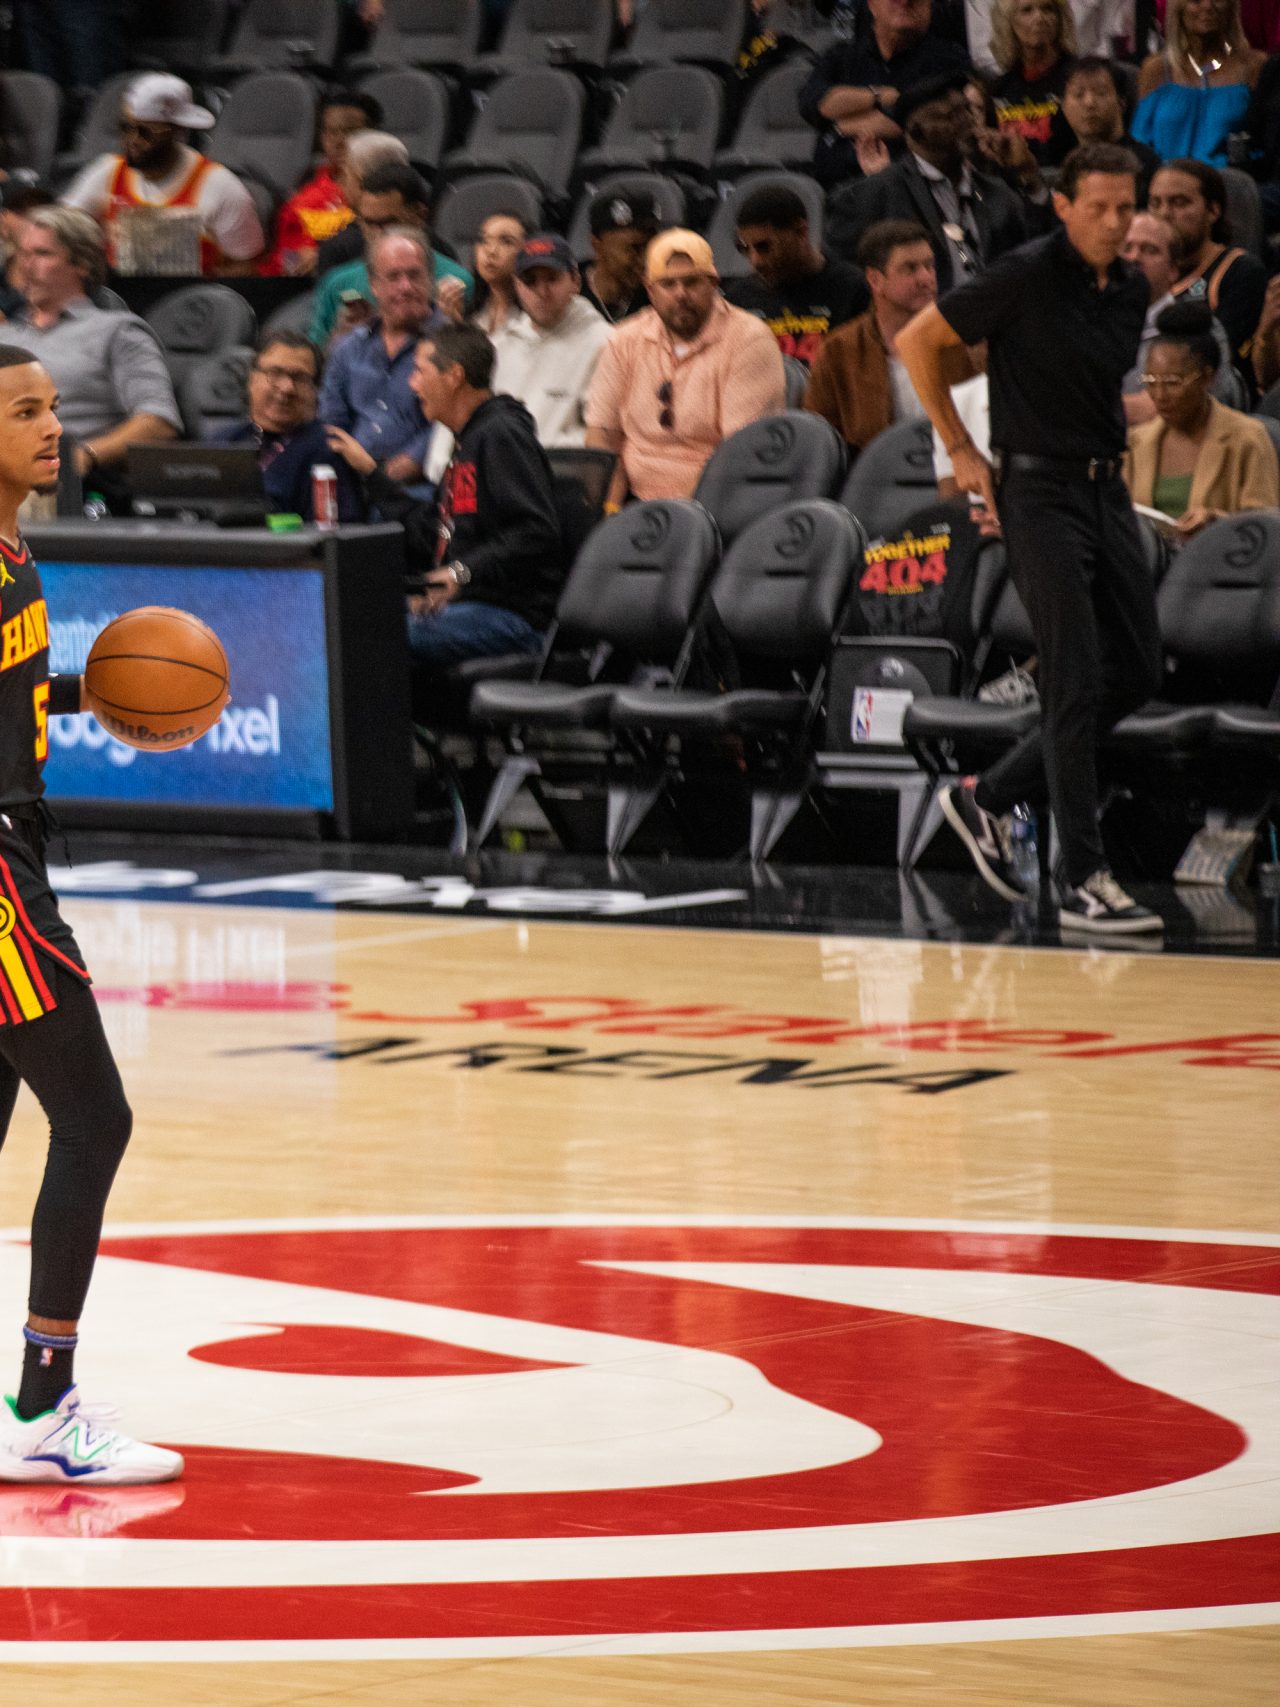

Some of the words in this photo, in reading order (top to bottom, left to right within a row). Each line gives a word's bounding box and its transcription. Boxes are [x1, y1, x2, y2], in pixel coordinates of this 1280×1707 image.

[859, 548, 948, 594] 404
[0, 598, 49, 673] HAW
[33, 680, 50, 762] 5
